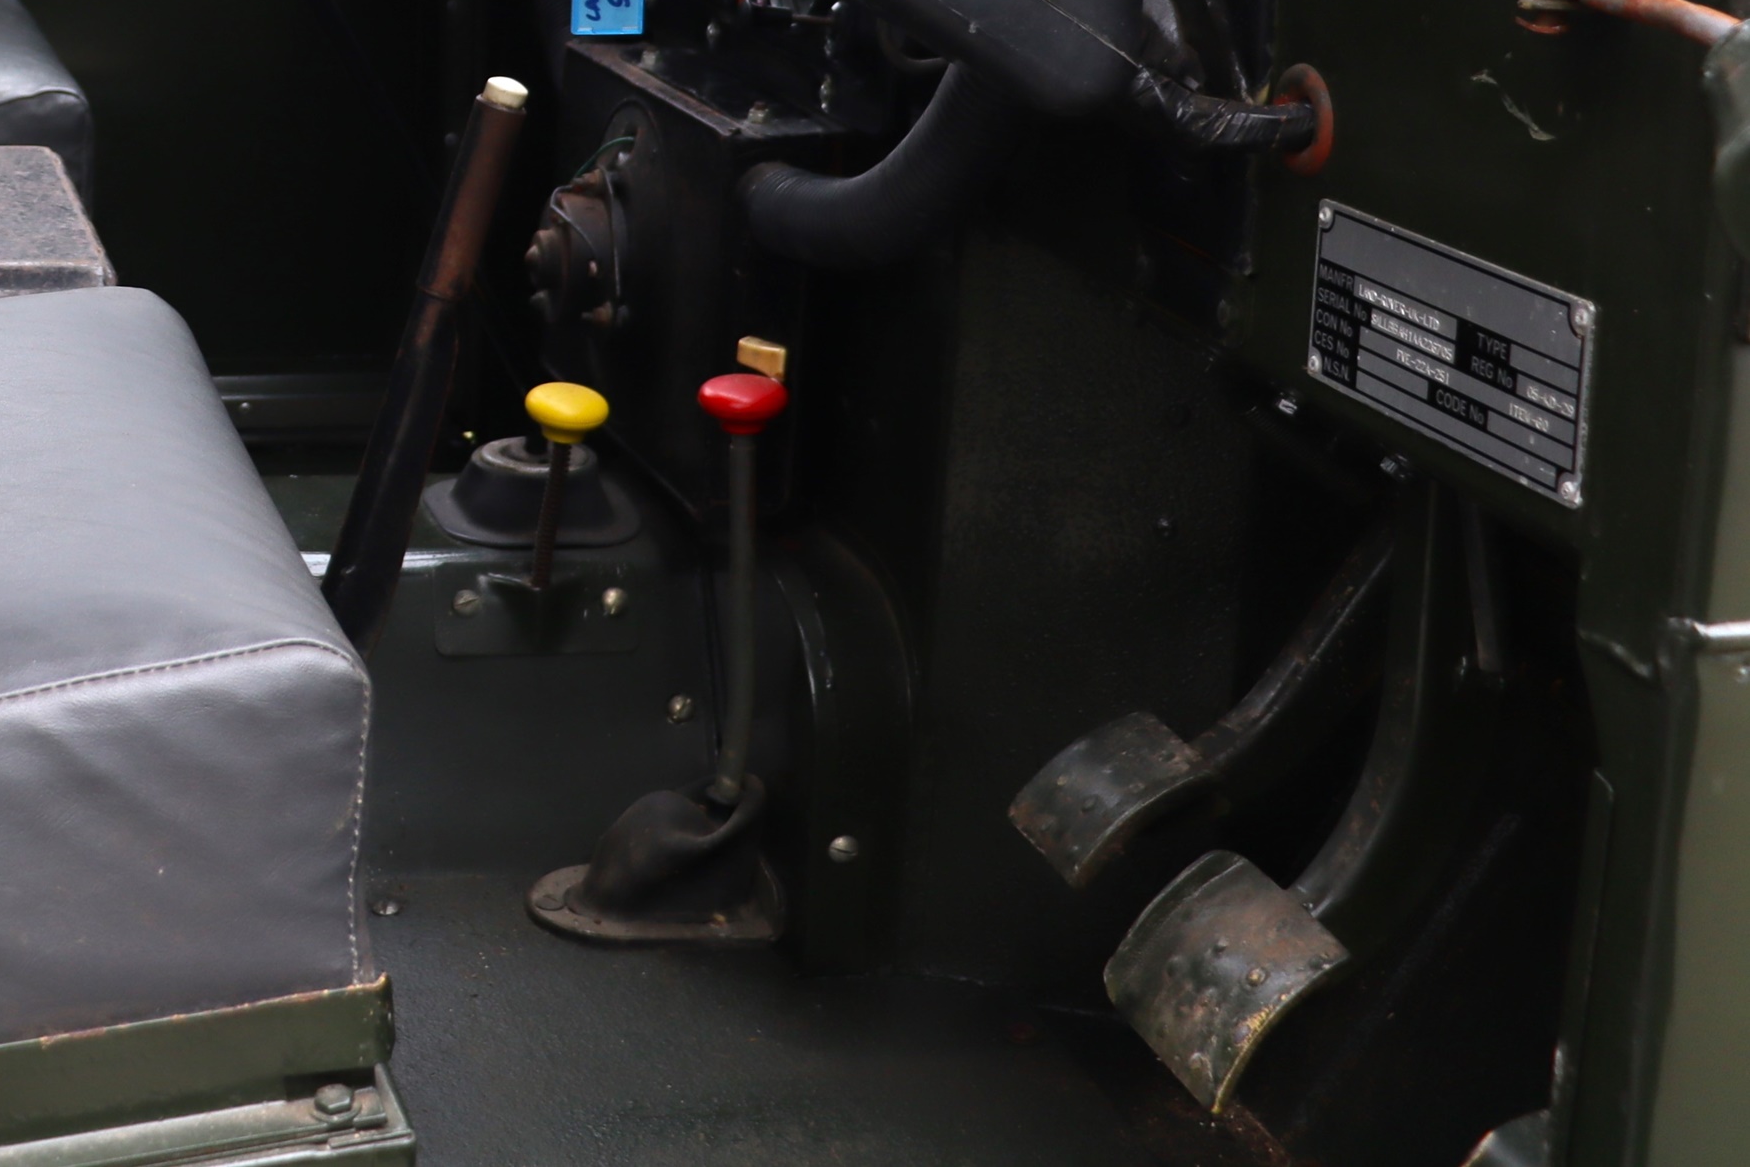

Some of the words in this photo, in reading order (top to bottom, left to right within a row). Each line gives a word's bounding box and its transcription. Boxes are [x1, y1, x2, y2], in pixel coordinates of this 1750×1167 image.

[1318, 264, 1353, 291] MANFR
[1317, 287, 1350, 314] SERIAL
[1353, 304, 1367, 322] No
[1315, 307, 1337, 329] CON
[1338, 318, 1352, 337] No
[1314, 330, 1334, 351] CES
[1336, 341, 1349, 359] No
[1476, 332, 1507, 360] TYPE
[1470, 356, 1494, 380] REG
[1496, 368, 1513, 389] No
[1435, 388, 1467, 416] CODE
[1469, 404, 1484, 425] No
